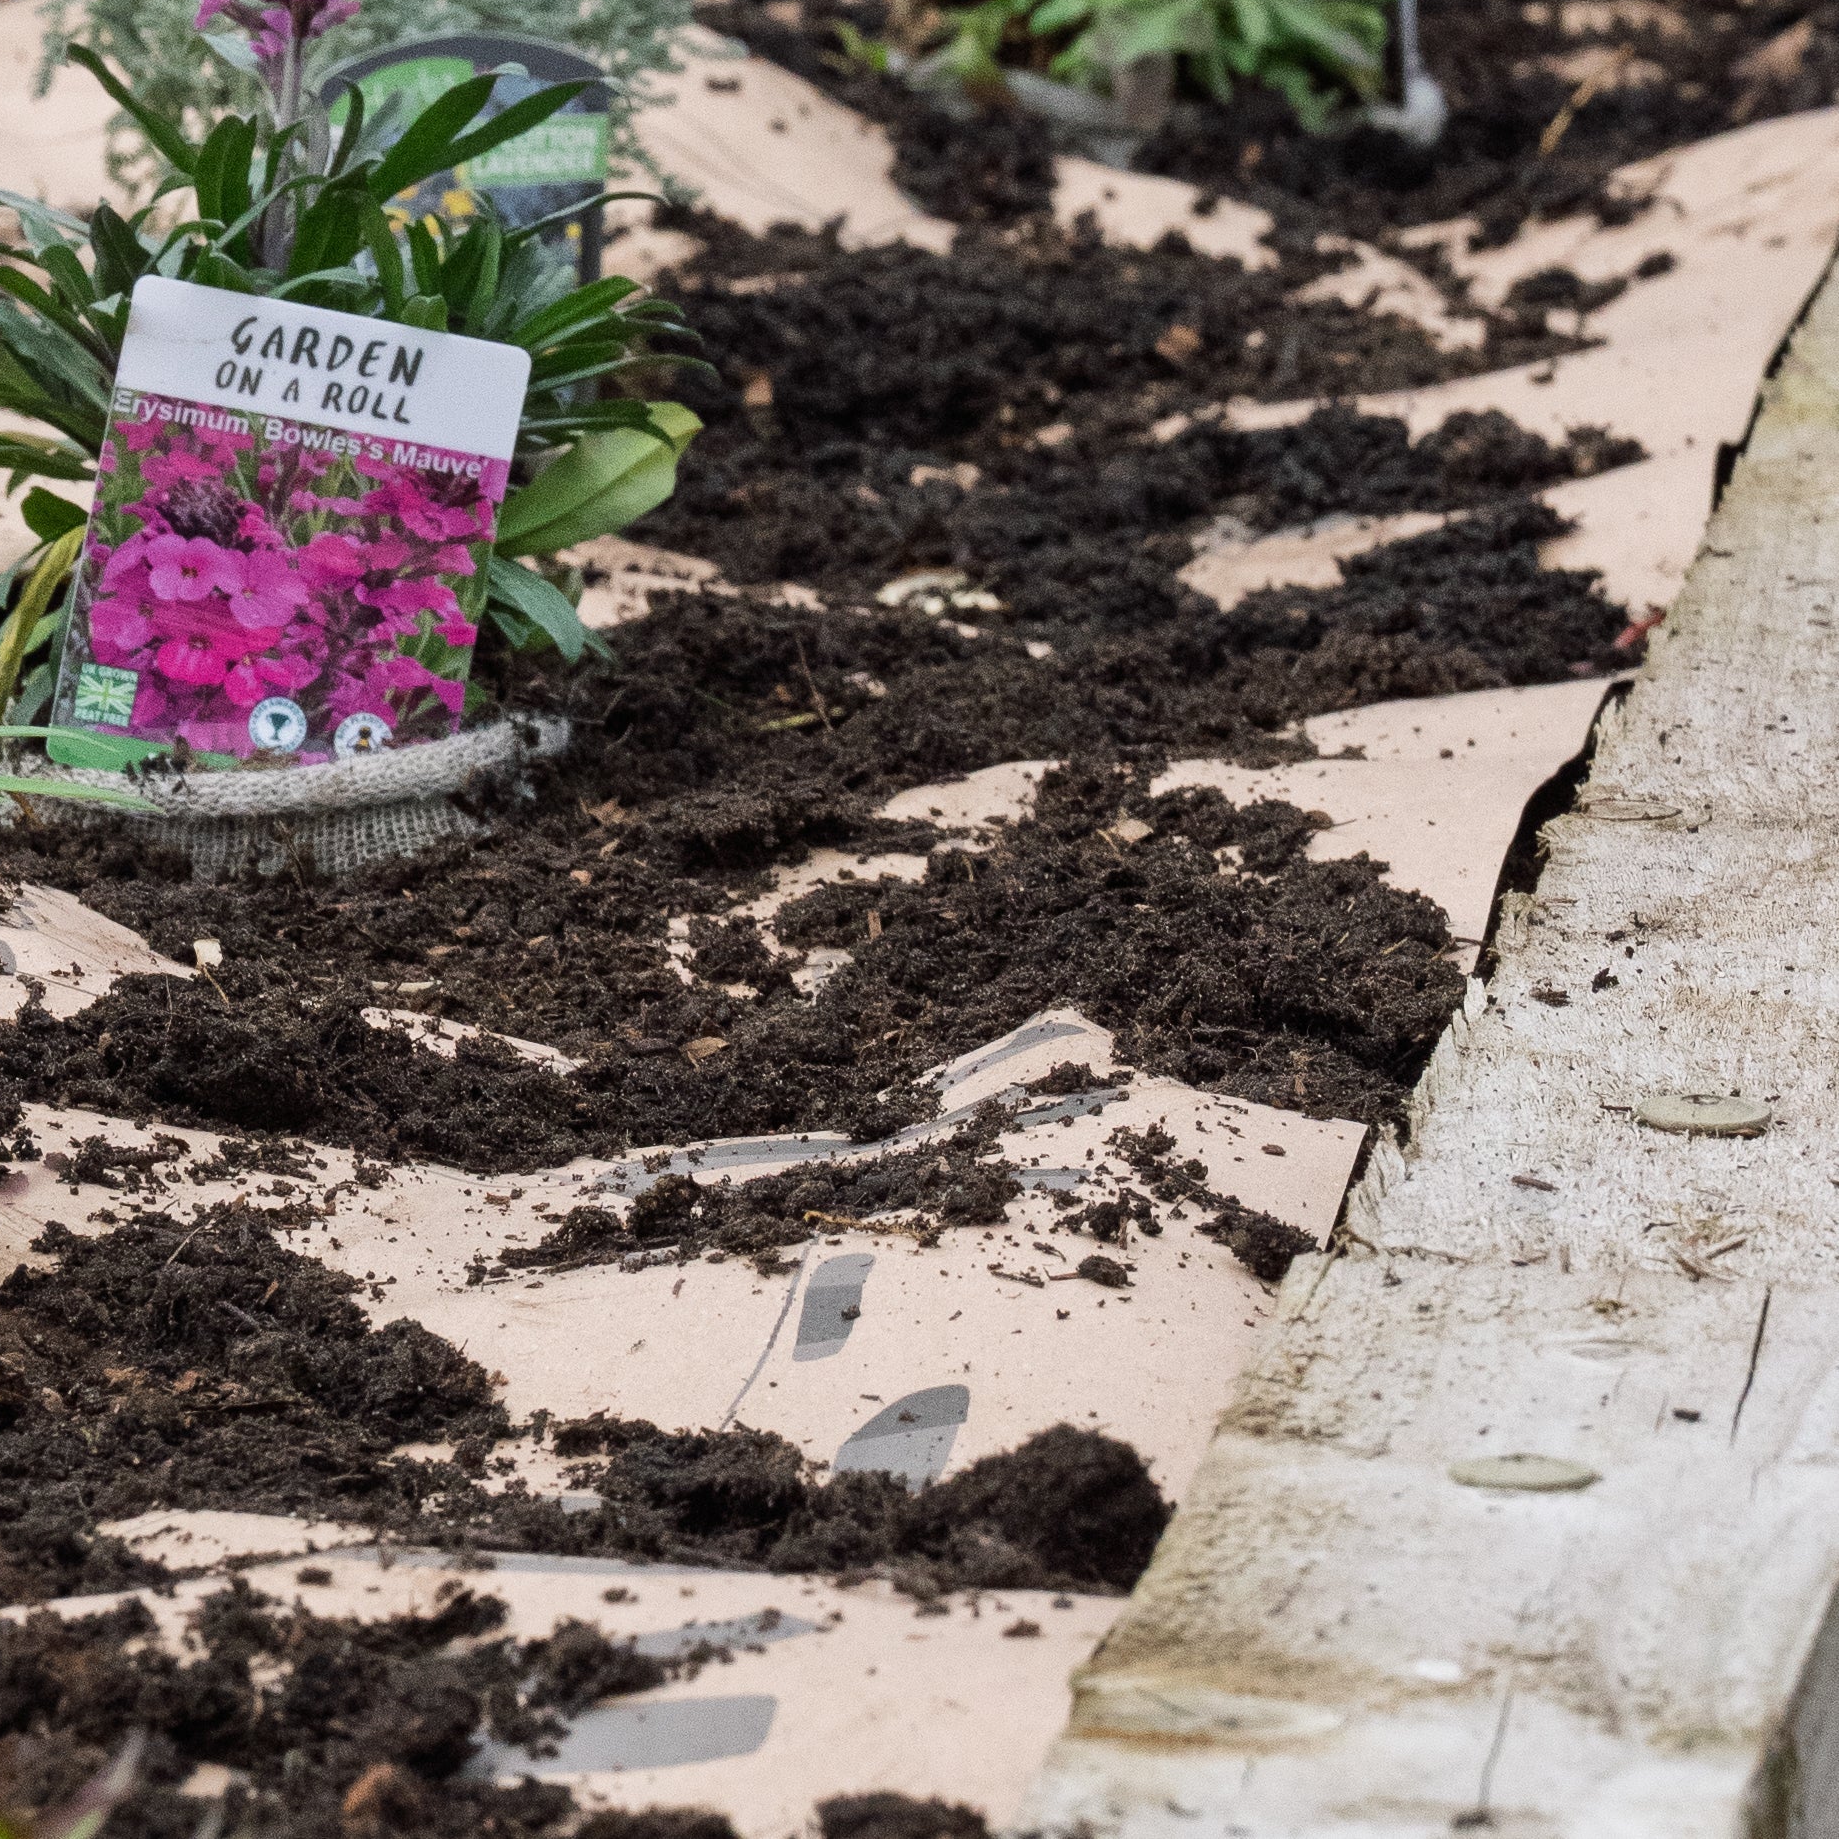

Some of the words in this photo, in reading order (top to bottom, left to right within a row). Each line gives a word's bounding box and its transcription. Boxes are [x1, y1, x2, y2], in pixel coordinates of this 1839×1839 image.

[230, 316, 424, 387] GARDEN
[214, 360, 264, 396] ON
[282, 378, 302, 403] A
[320, 382, 411, 425] ROLL
[113, 388, 250, 436] Erysimum
[391, 441, 489, 480] Mauve'
